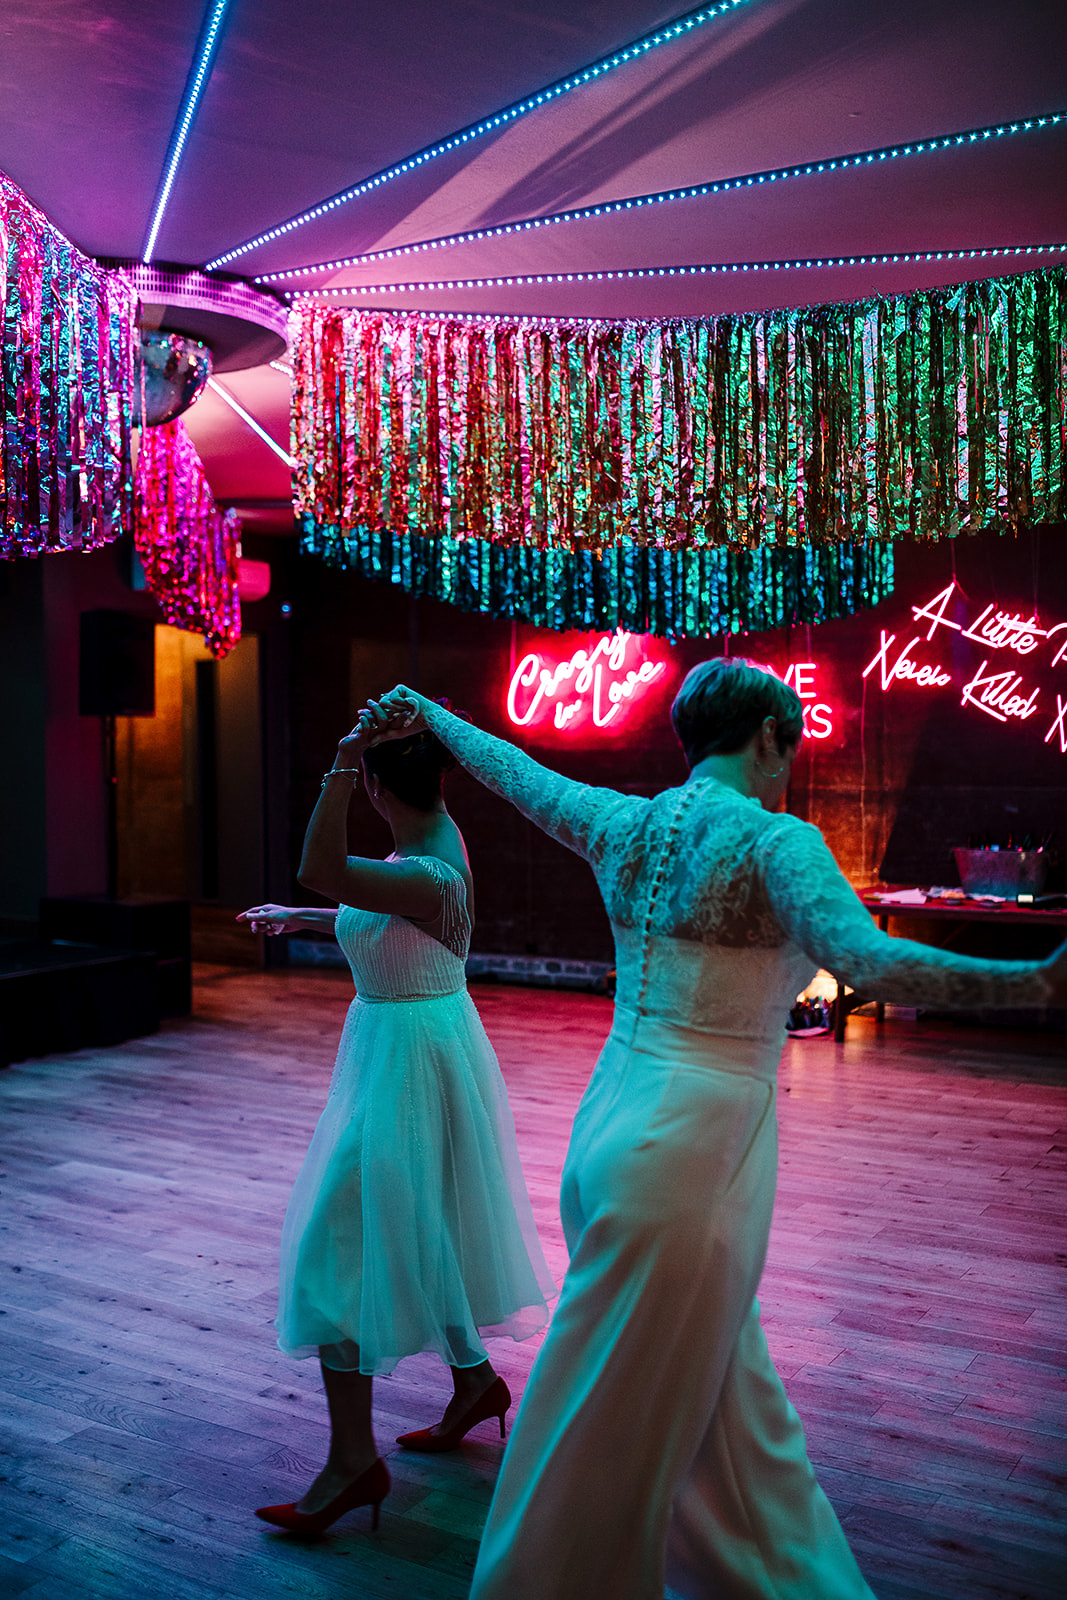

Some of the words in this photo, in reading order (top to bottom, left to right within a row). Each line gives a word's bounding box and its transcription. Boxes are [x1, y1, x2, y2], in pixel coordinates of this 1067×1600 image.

[911, 582, 962, 641] A
[961, 603, 1049, 655] Little
[506, 626, 632, 726] Crazy
[592, 661, 665, 727] Love
[862, 629, 952, 691] Never
[960, 659, 1041, 722] Killed
